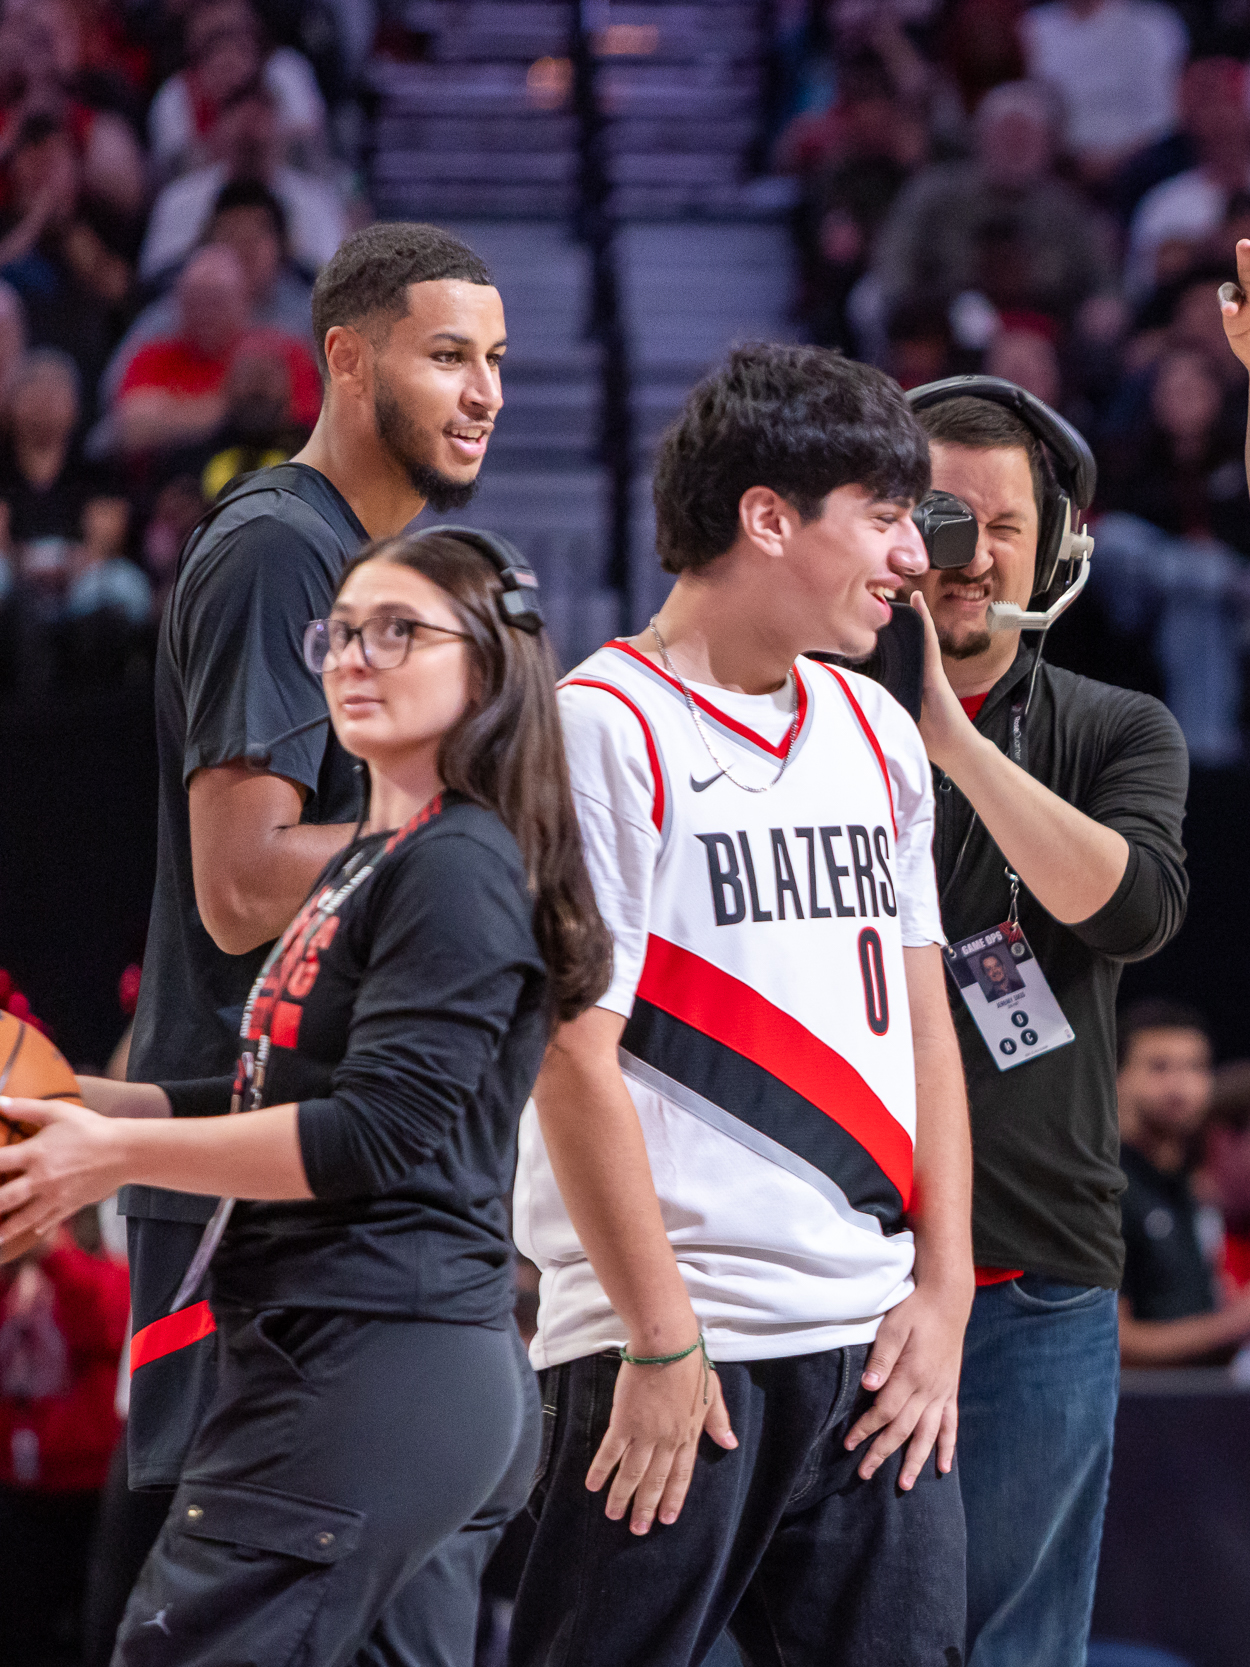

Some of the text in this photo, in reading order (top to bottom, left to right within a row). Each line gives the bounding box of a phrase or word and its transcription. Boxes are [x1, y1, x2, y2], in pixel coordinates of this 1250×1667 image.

[693, 824, 898, 927] BLAZERS
[857, 926, 890, 1037] 0
[961, 930, 1003, 955] GAME OPS
